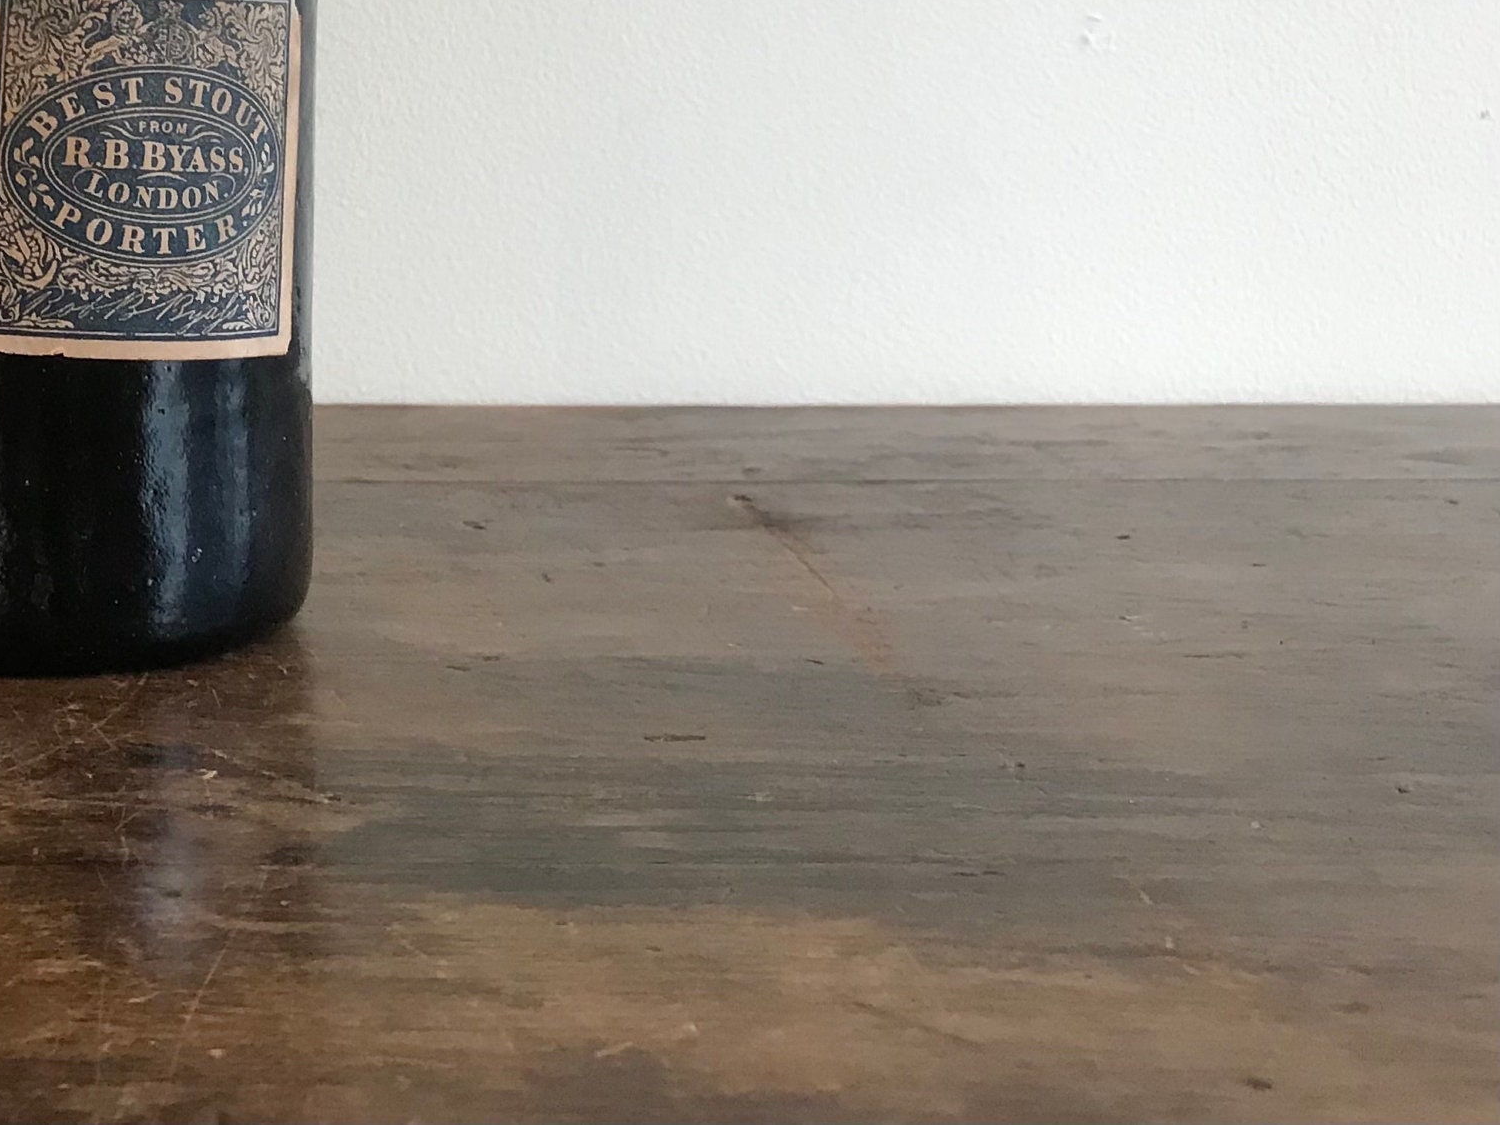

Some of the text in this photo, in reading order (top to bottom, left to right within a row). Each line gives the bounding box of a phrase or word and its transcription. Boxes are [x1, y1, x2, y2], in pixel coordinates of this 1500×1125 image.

[27, 76, 269, 144] BEST STOUT
[138, 120, 188, 135] FROM
[83, 173, 230, 210] LONDON.
[50, 201, 248, 255] PORTER.
